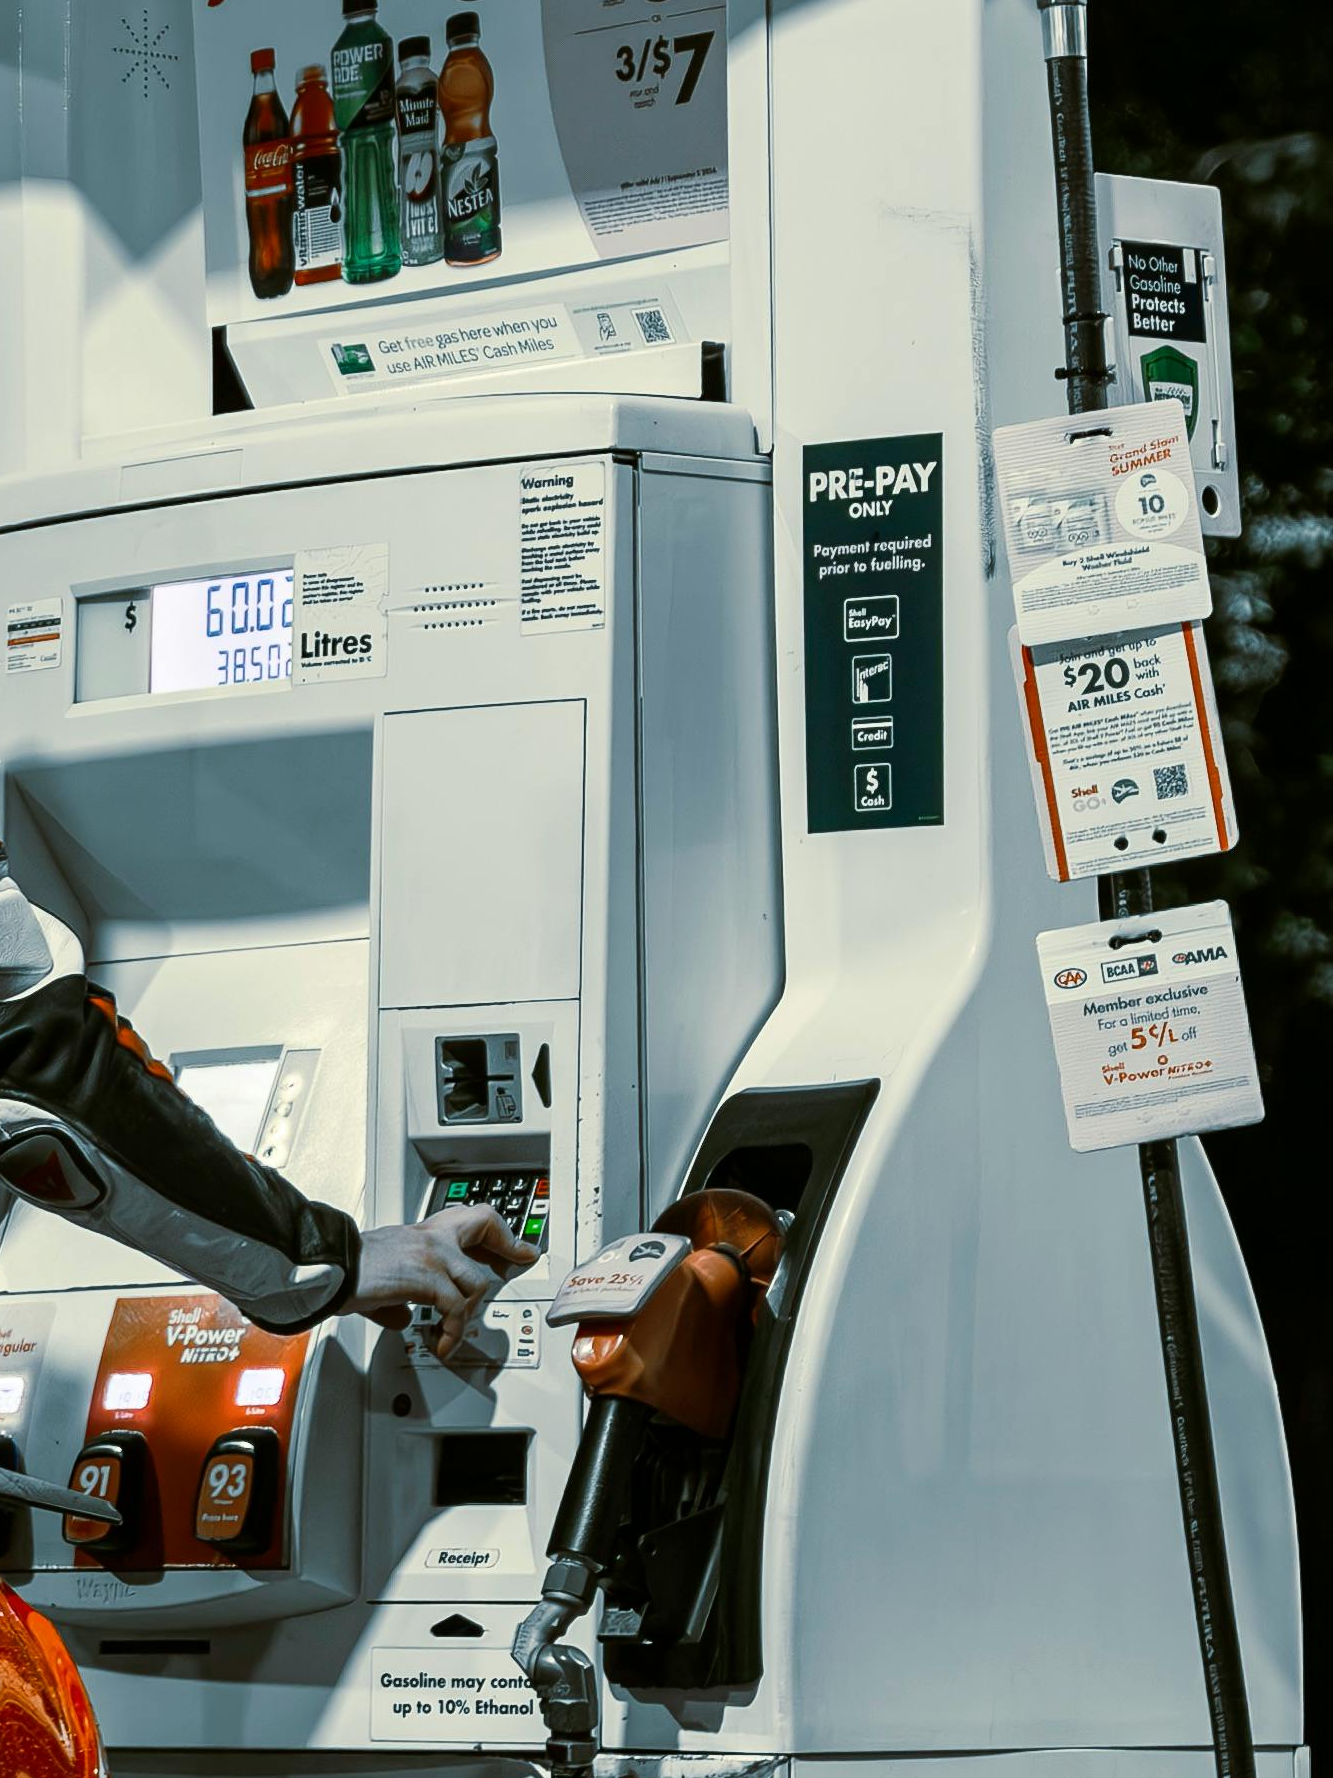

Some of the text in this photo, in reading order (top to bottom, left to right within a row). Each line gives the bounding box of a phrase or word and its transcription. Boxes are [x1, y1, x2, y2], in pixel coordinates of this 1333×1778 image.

[447, 188, 495, 219] NESTEA
[1128, 255, 1179, 274] No Other
[1130, 274, 1182, 295] Gasoline
[1132, 293, 1186, 315] Protects
[1133, 312, 1175, 332] Better
[379, 316, 558, 354] Get free gas here when you
[387, 336, 555, 374] use AIR Cash Miles
[1111, 448, 1172, 477] SUMMER
[521, 474, 574, 490] Warning
[809, 461, 937, 503] PRE-PAY
[849, 500, 893, 519] ONLY
[1138, 494, 1165, 515] 10
[813, 534, 932, 558] Payment required
[819, 555, 926, 580] prior to fuelling.
[124, 601, 137, 634] $
[301, 629, 373, 659] Litres
[1060, 637, 1157, 665] Join and get up to
[1133, 654, 1162, 669] back
[1063, 657, 1130, 696] $20
[1135, 666, 1160, 681] with
[1067, 690, 1132, 713] AIR MILES
[857, 729, 888, 742] Credit
[866, 767, 879, 794] $
[861, 795, 885, 807] Cash
[1071, 784, 1099, 799] Shell
[1184, 945, 1228, 965] AMA
[1057, 972, 1083, 986] CAA
[1106, 961, 1136, 978] BCAA
[1083, 985, 1209, 1017] Member exclusive
[1097, 1006, 1170, 1031] For a limited
[1108, 1042, 1128, 1058] get
[1181, 1026, 1198, 1042] off
[1101, 1062, 1125, 1074] Shell
[1103, 1067, 1166, 1087] V-Power
[567, 1274, 606, 1289] Save
[167, 1307, 203, 1325] Shell
[165, 1324, 247, 1348] V-Power
[79, 1464, 247, 1499] 91 93
[438, 1551, 491, 1568] Receipt
[76, 1578, 136, 1604] Wayne
[380, 1672, 534, 1693] Gasoline may conta
[393, 1698, 534, 1718] up to 10% Ethanol
